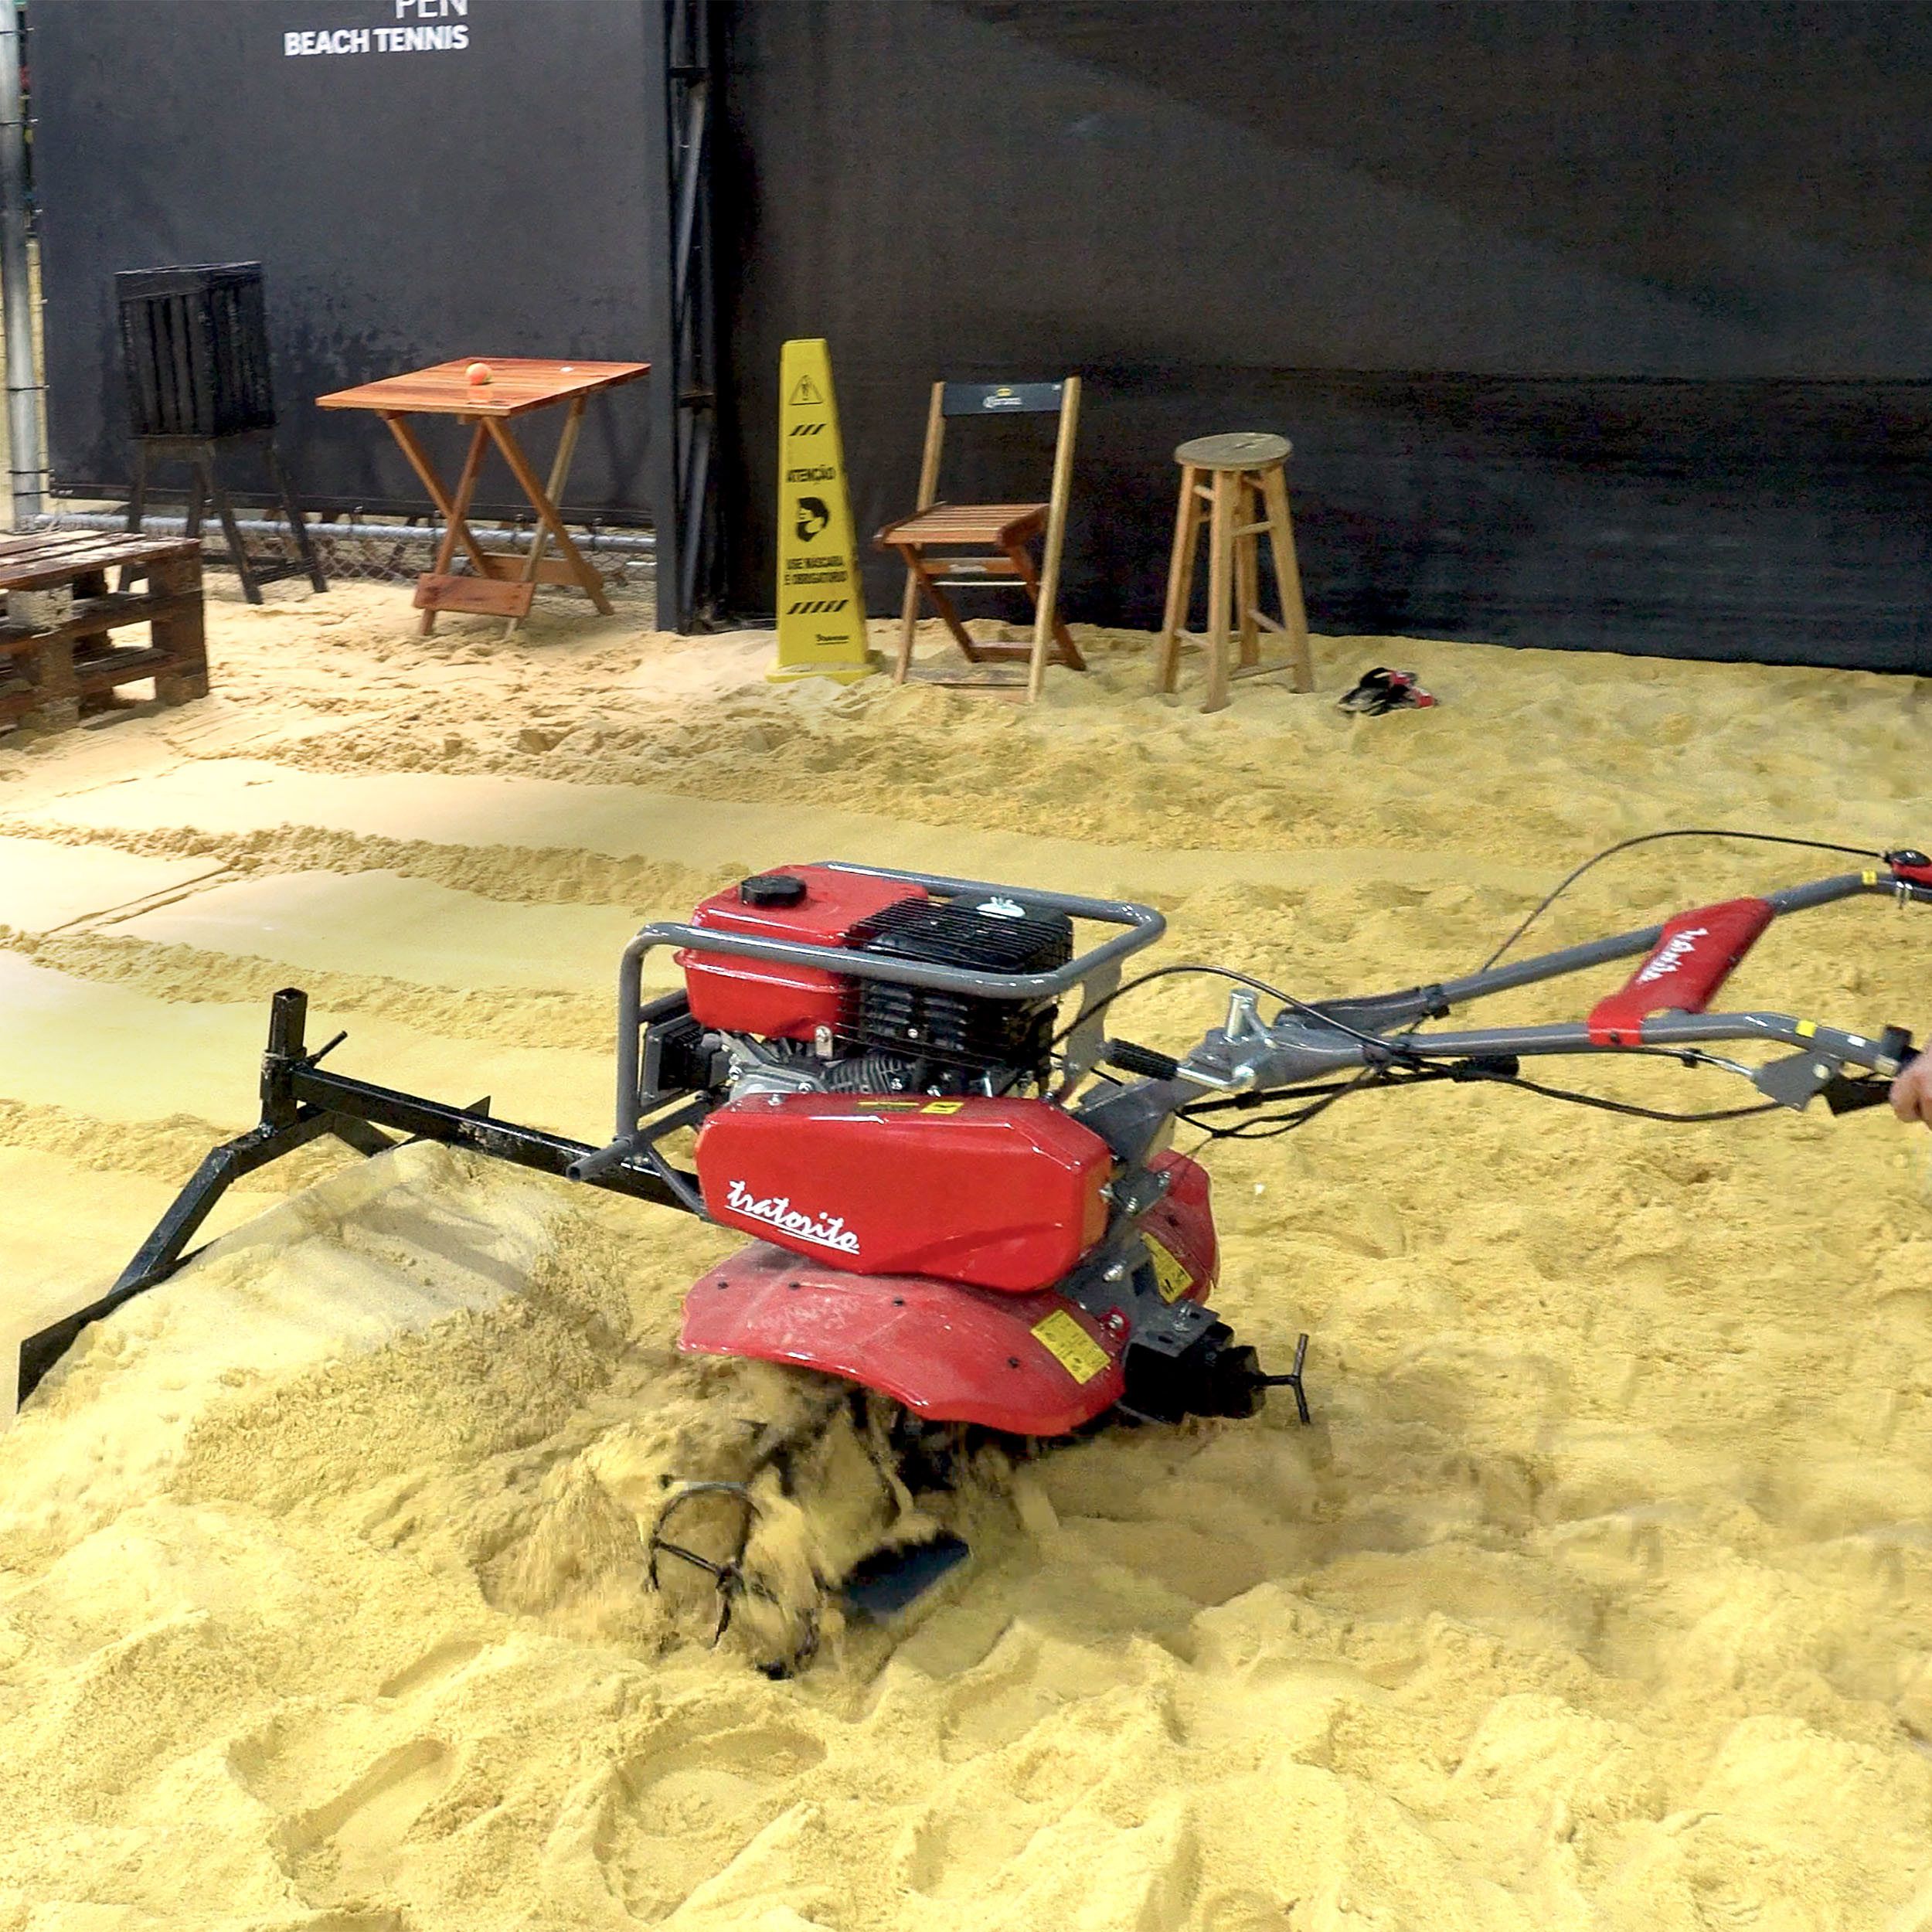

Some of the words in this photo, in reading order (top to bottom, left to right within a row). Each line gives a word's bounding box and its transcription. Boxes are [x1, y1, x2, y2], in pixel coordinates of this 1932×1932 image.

[284, 29, 369, 56] BEACH
[372, 24, 469, 53] TENNIS
[725, 1180, 861, 1250] tratorito
